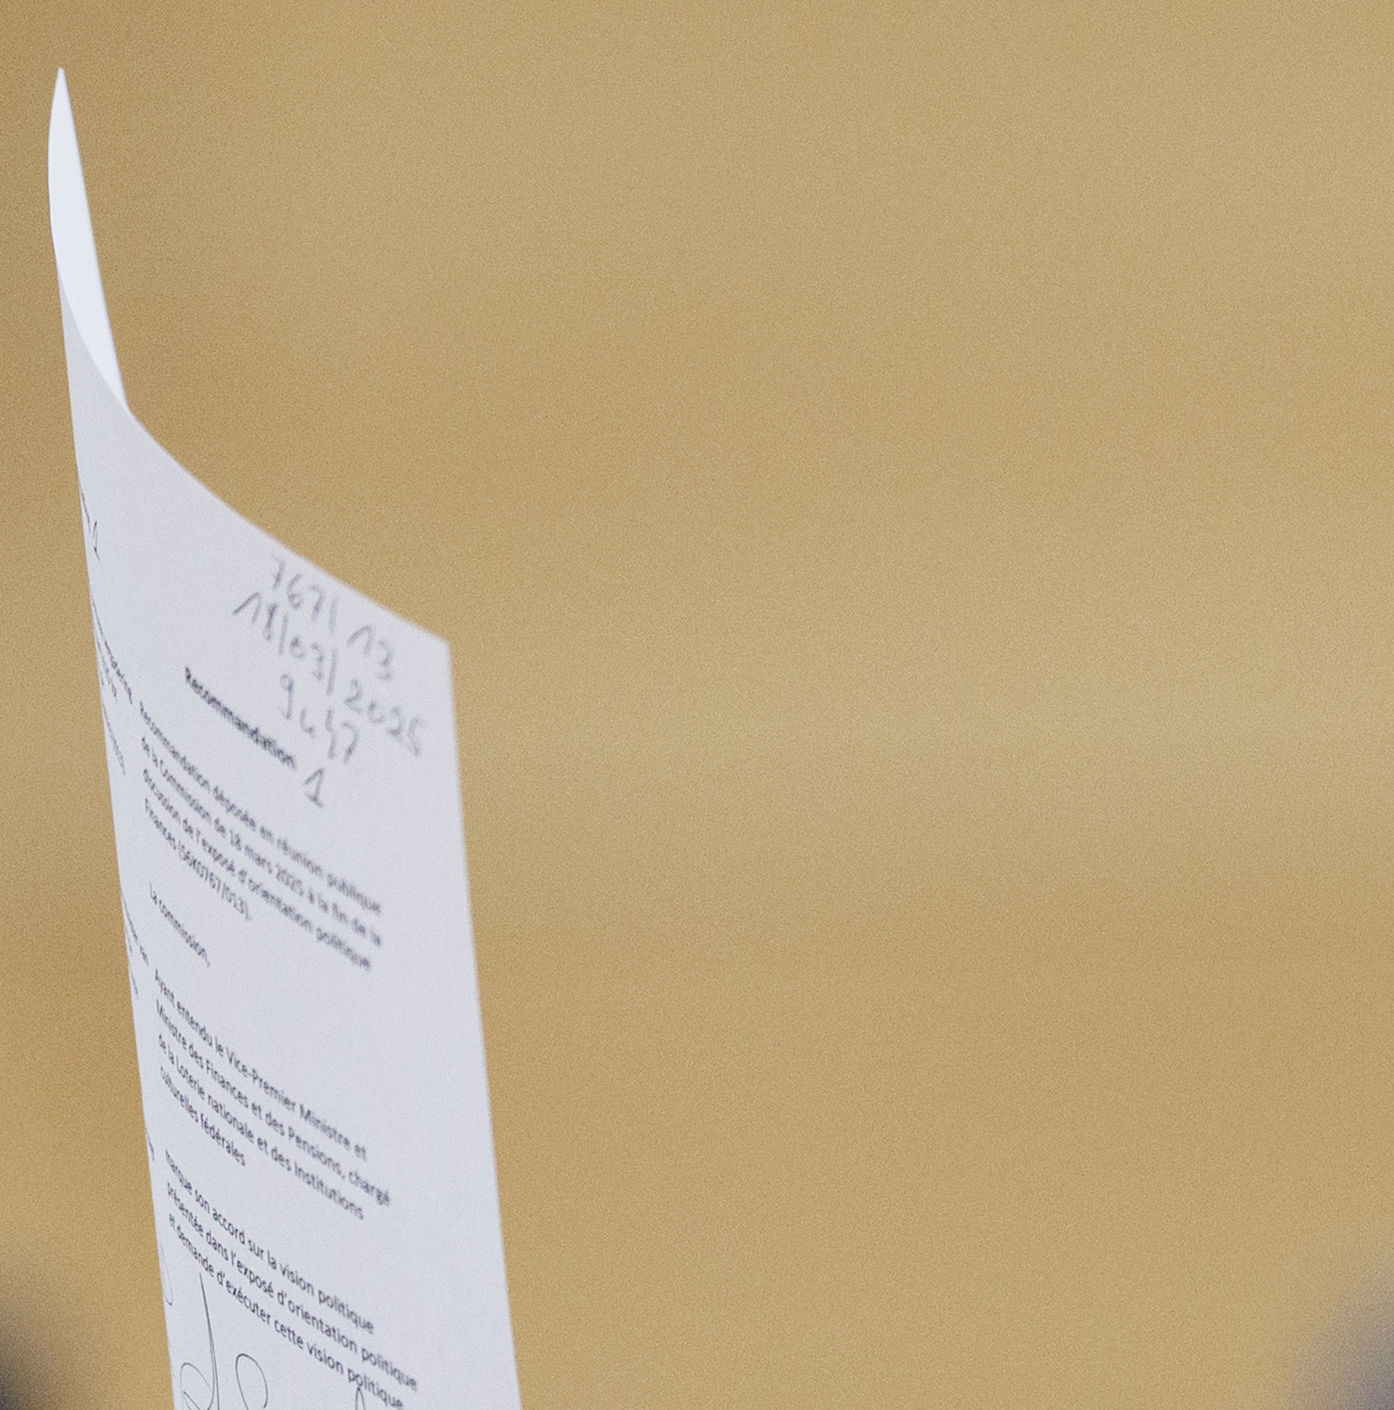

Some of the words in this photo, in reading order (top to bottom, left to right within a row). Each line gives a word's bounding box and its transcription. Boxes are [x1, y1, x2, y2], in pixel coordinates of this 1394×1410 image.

[185, 666, 296, 769] Recommandation
[155, 969, 174, 1006] Ayant
[177, 1001, 213, 1047] entendu
[226, 1048, 296, 1111] Vice-Premier
[300, 1104, 350, 1150] Ministre
[156, 1000, 187, 1050] Ministre
[189, 1044, 204, 1069] des
[206, 1059, 249, 1108] Finances
[265, 1112, 285, 1136] des
[288, 1126, 345, 1179] Pensions,
[349, 1172, 390, 1206] chargé
[160, 1067, 199, 1123] culturelles
[176, 1054, 205, 1100] Loterie
[208, 1095, 254, 1143] nationale
[271, 1147, 291, 1171] des
[295, 1162, 364, 1220] Institutions
[165, 1151, 192, 1195] marque
[195, 1190, 210, 1213] son
[212, 1208, 245, 1245] accord
[248, 1239, 264, 1259] sur
[280, 1264, 314, 1296] vision
[318, 1290, 374, 1334] politique
[167, 1183, 204, 1237] présentée
[206, 1231, 229, 1261] dans
[231, 1251, 274, 1298] l'exposé
[277, 1291, 357, 1353] d'orientation
[361, 1348, 417, 1391] politique
[177, 1225, 214, 1277] demande
[216, 1271, 271, 1325] d'exécuter
[274, 1320, 304, 1349] cette
[307, 1343, 344, 1374] vision
